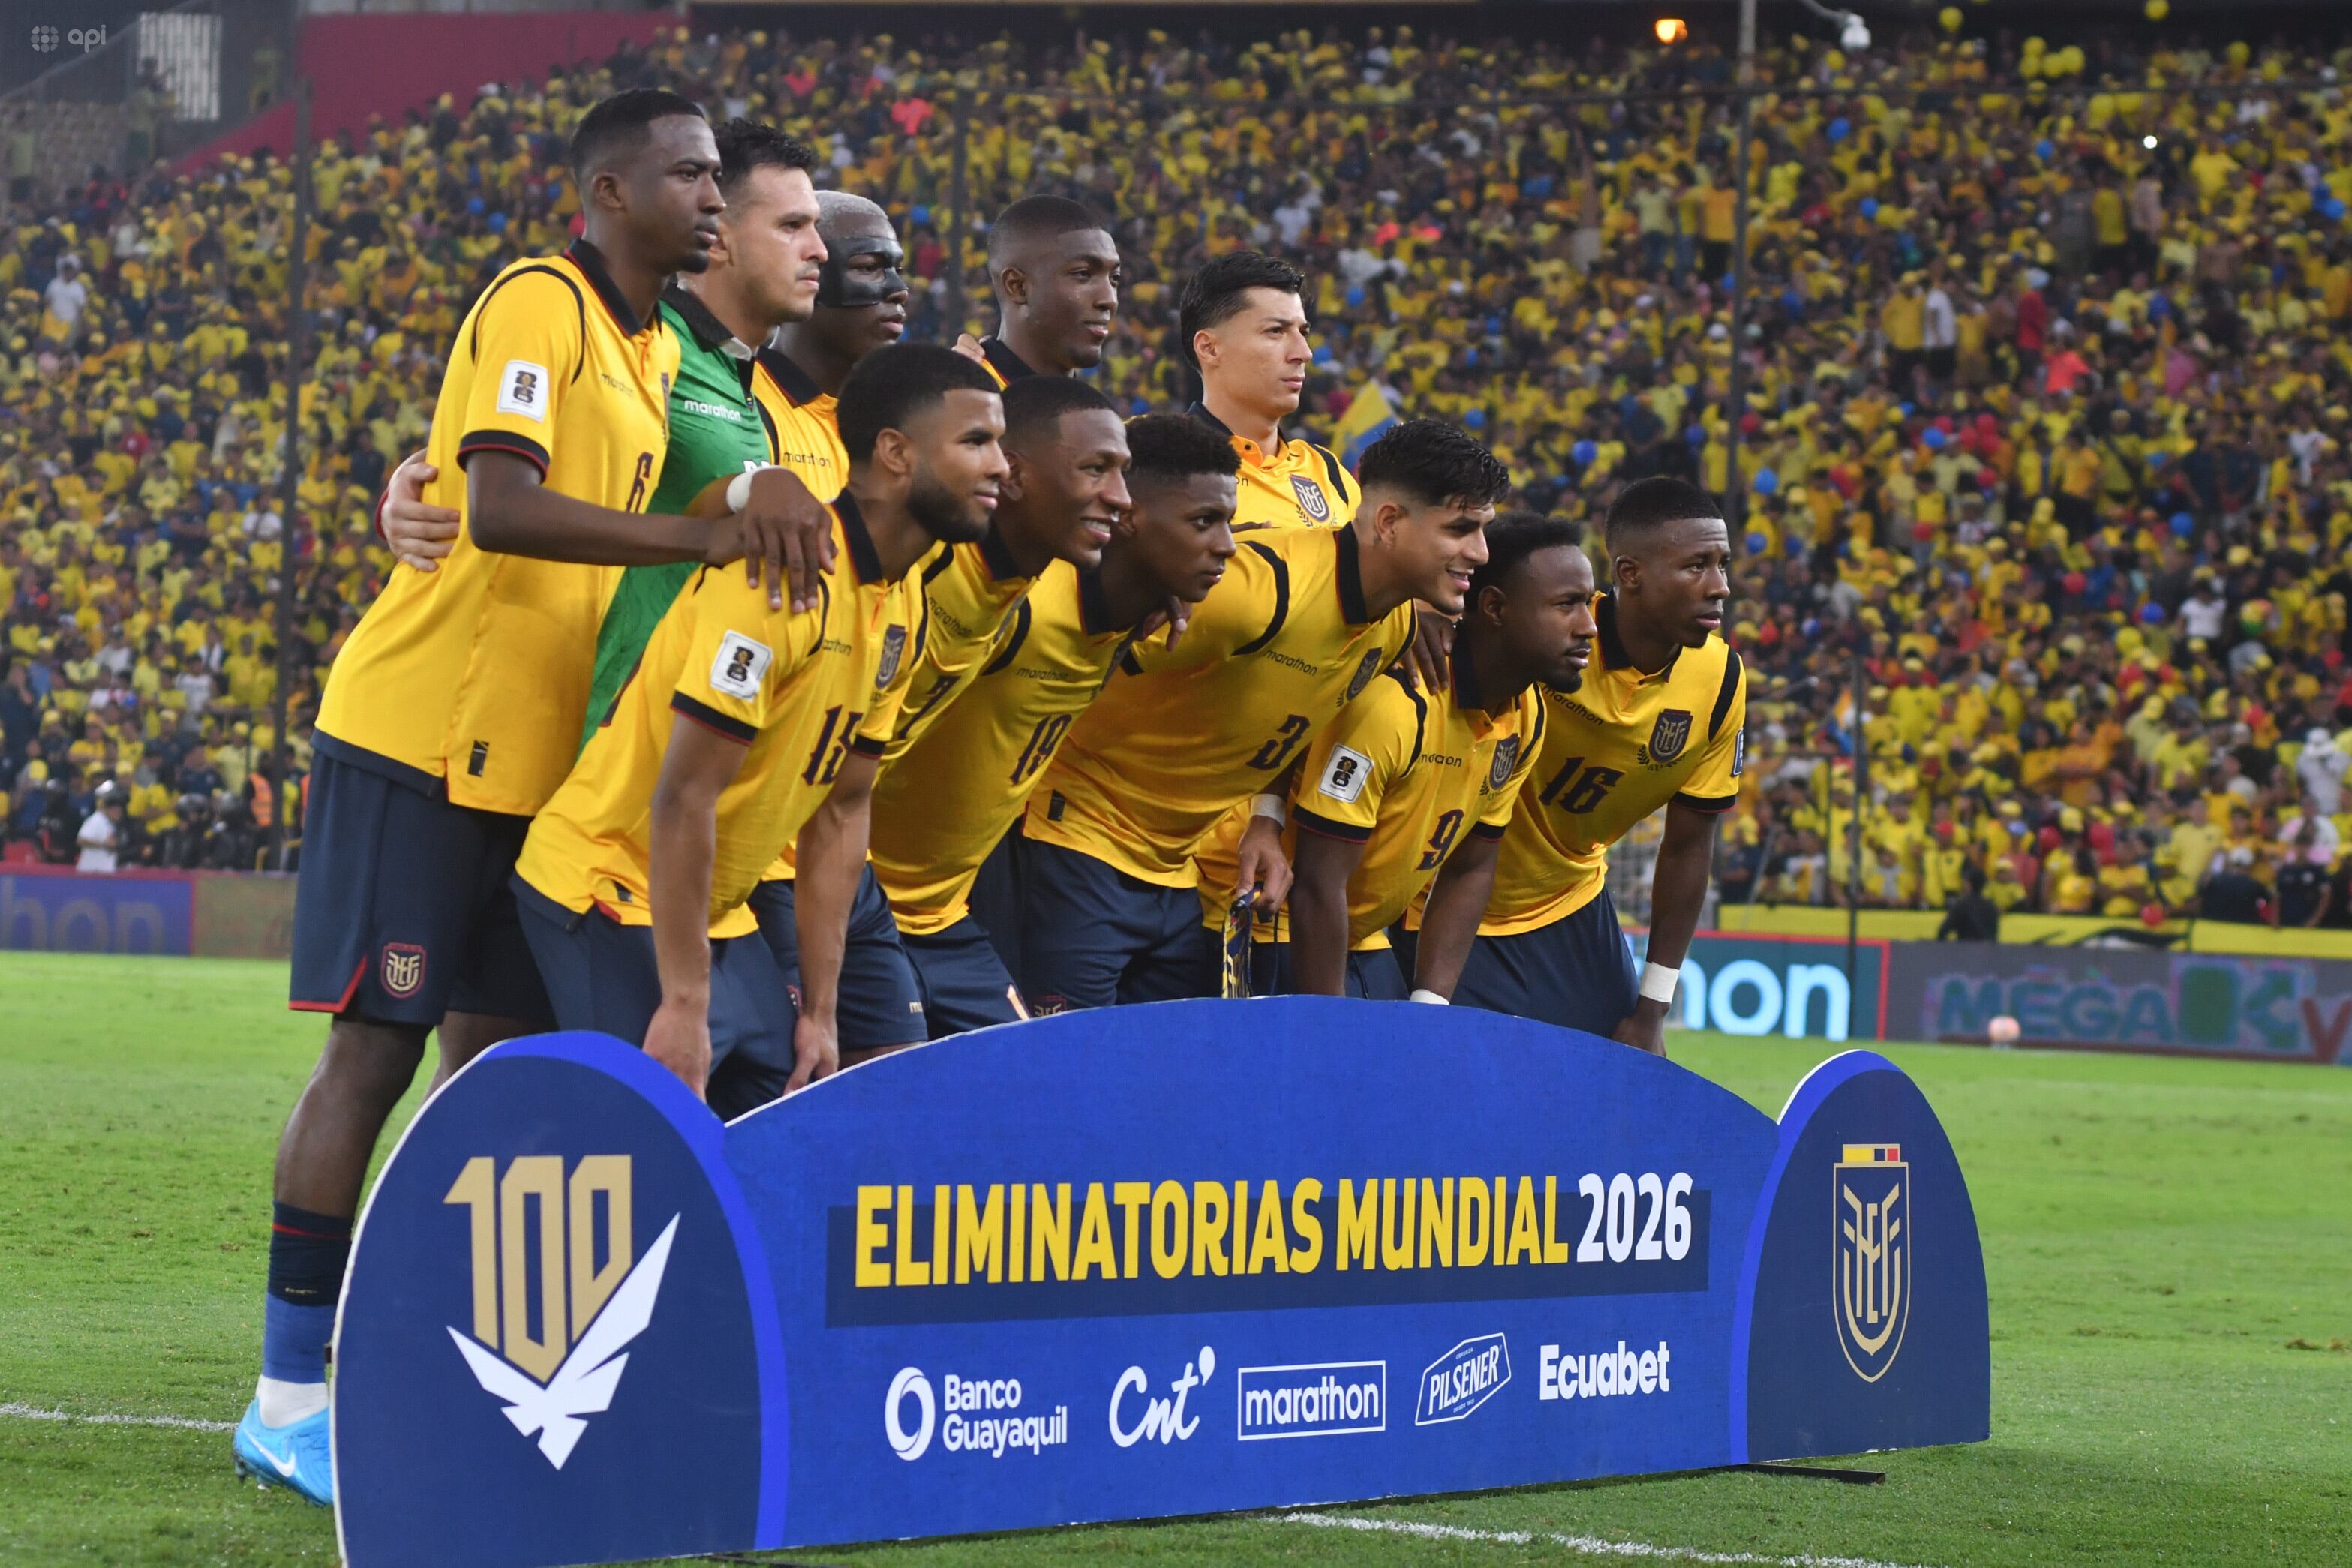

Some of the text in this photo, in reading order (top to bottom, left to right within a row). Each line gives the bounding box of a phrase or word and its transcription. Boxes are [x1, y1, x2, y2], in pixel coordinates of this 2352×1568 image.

[684, 399, 741, 421] marathon
[1263, 650, 1318, 677] marathon
[1542, 684, 1604, 725] marathon
[1246, 714, 1310, 770] 3
[1539, 757, 1626, 814] 16
[1415, 809, 1465, 871] 9
[1937, 974, 2174, 1043] MEGA
[855, 1172, 1693, 1287] ELIMINATORIAS MUNDIAL 2026
[944, 1374, 1022, 1411] Banco
[1428, 1345, 1499, 1416] PILSENER
[1539, 1341, 1669, 1400] Ecuabet
[1245, 1375, 1379, 1425] marathon
[942, 1405, 1068, 1458] Guayaquil
